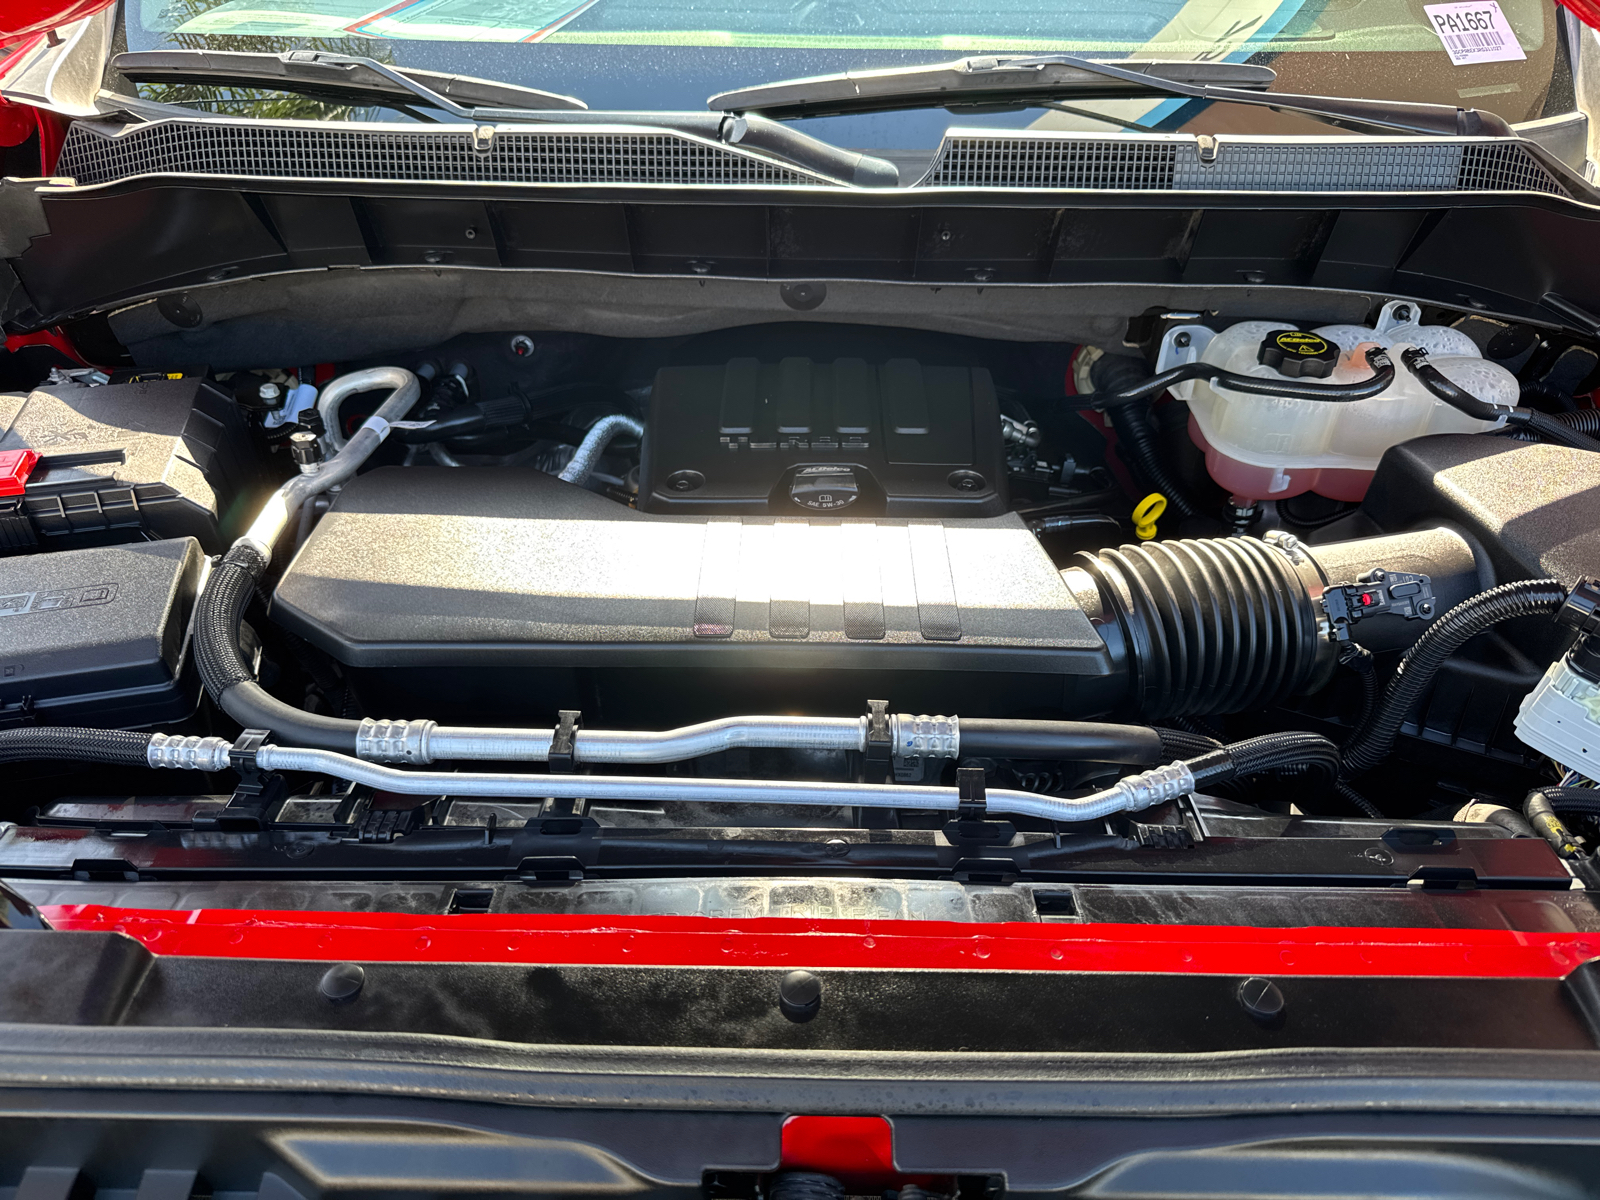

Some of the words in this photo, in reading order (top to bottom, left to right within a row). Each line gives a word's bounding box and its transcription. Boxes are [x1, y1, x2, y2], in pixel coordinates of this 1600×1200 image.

[1433, 10, 1496, 34] PA1667
[801, 466, 851, 474] ACDelco
[822, 500, 845, 508] 5W-30
